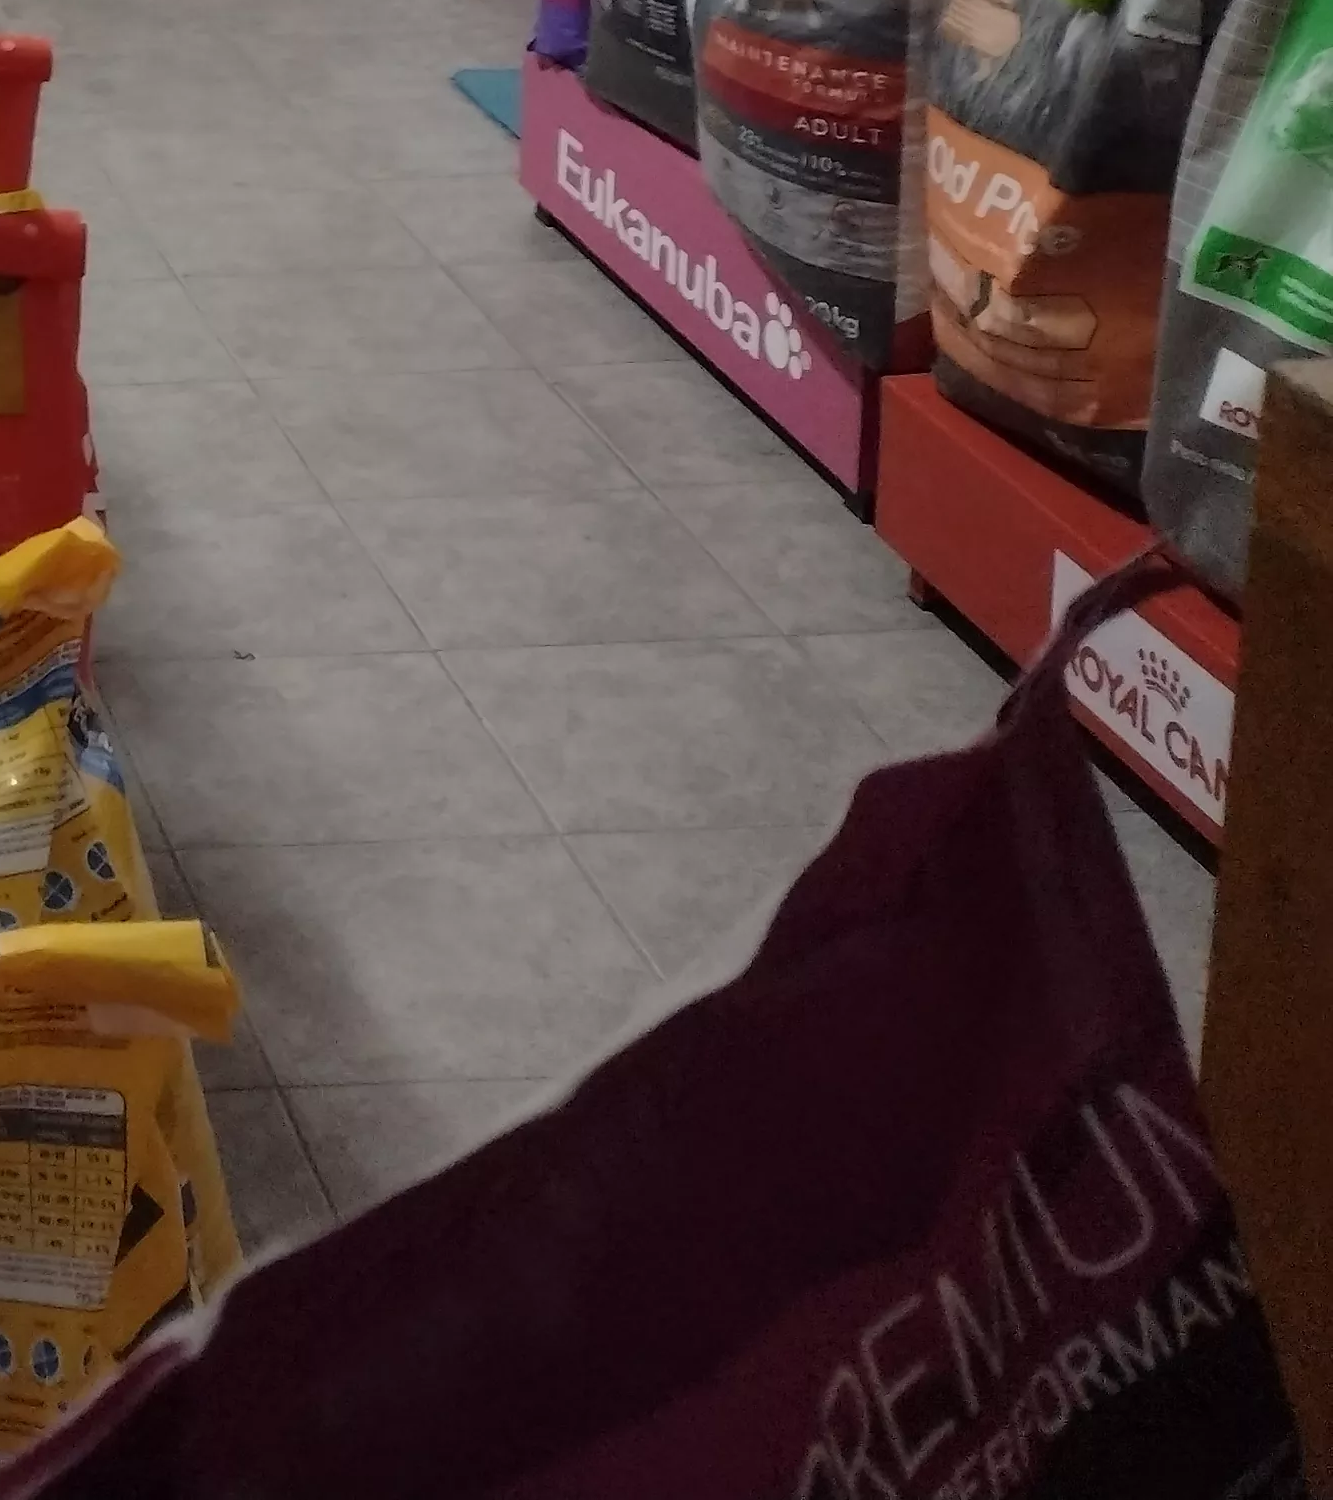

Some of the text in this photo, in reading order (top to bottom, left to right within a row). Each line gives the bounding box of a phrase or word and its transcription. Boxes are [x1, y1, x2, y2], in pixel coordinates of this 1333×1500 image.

[793, 115, 884, 147] ADULT
[929, 136, 979, 204] Old
[557, 127, 761, 360] Eukanuba
